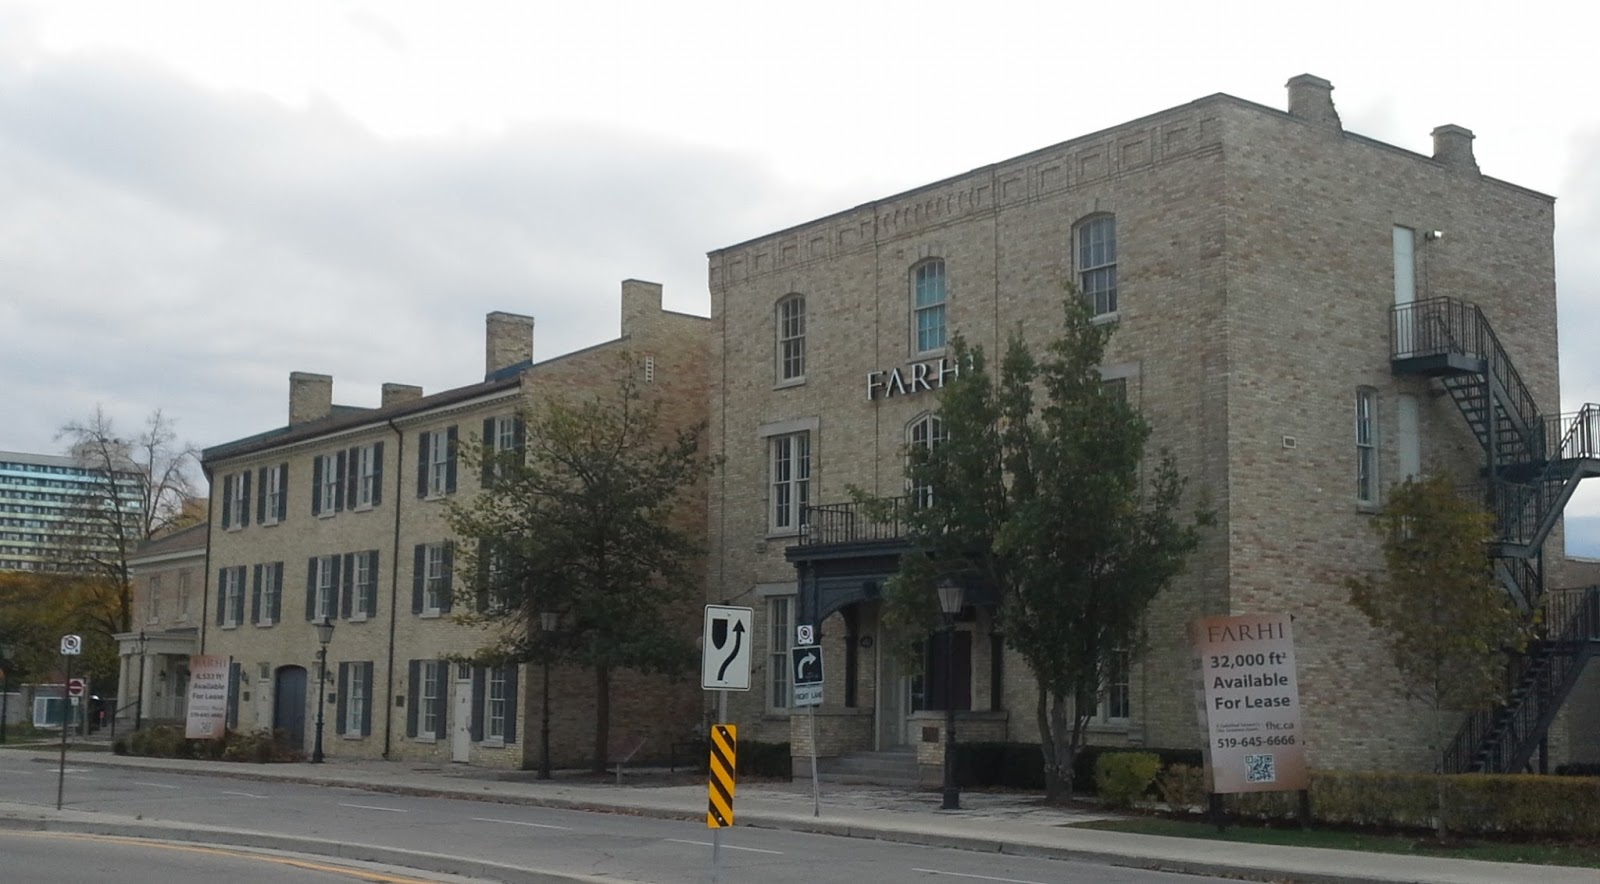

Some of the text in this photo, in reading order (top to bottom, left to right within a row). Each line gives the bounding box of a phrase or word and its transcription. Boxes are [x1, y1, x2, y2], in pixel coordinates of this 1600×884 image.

[1208, 622, 1284, 643] FARHI
[194, 659, 226, 668] FARHI
[1211, 654, 1265, 669] 32,000
[1213, 673, 1288, 688] Available
[192, 692, 204, 700] For
[1215, 696, 1290, 710] For Lease
[1266, 721, 1294, 730] fhc.ca
[1217, 735, 1296, 748] 519-645-6666
